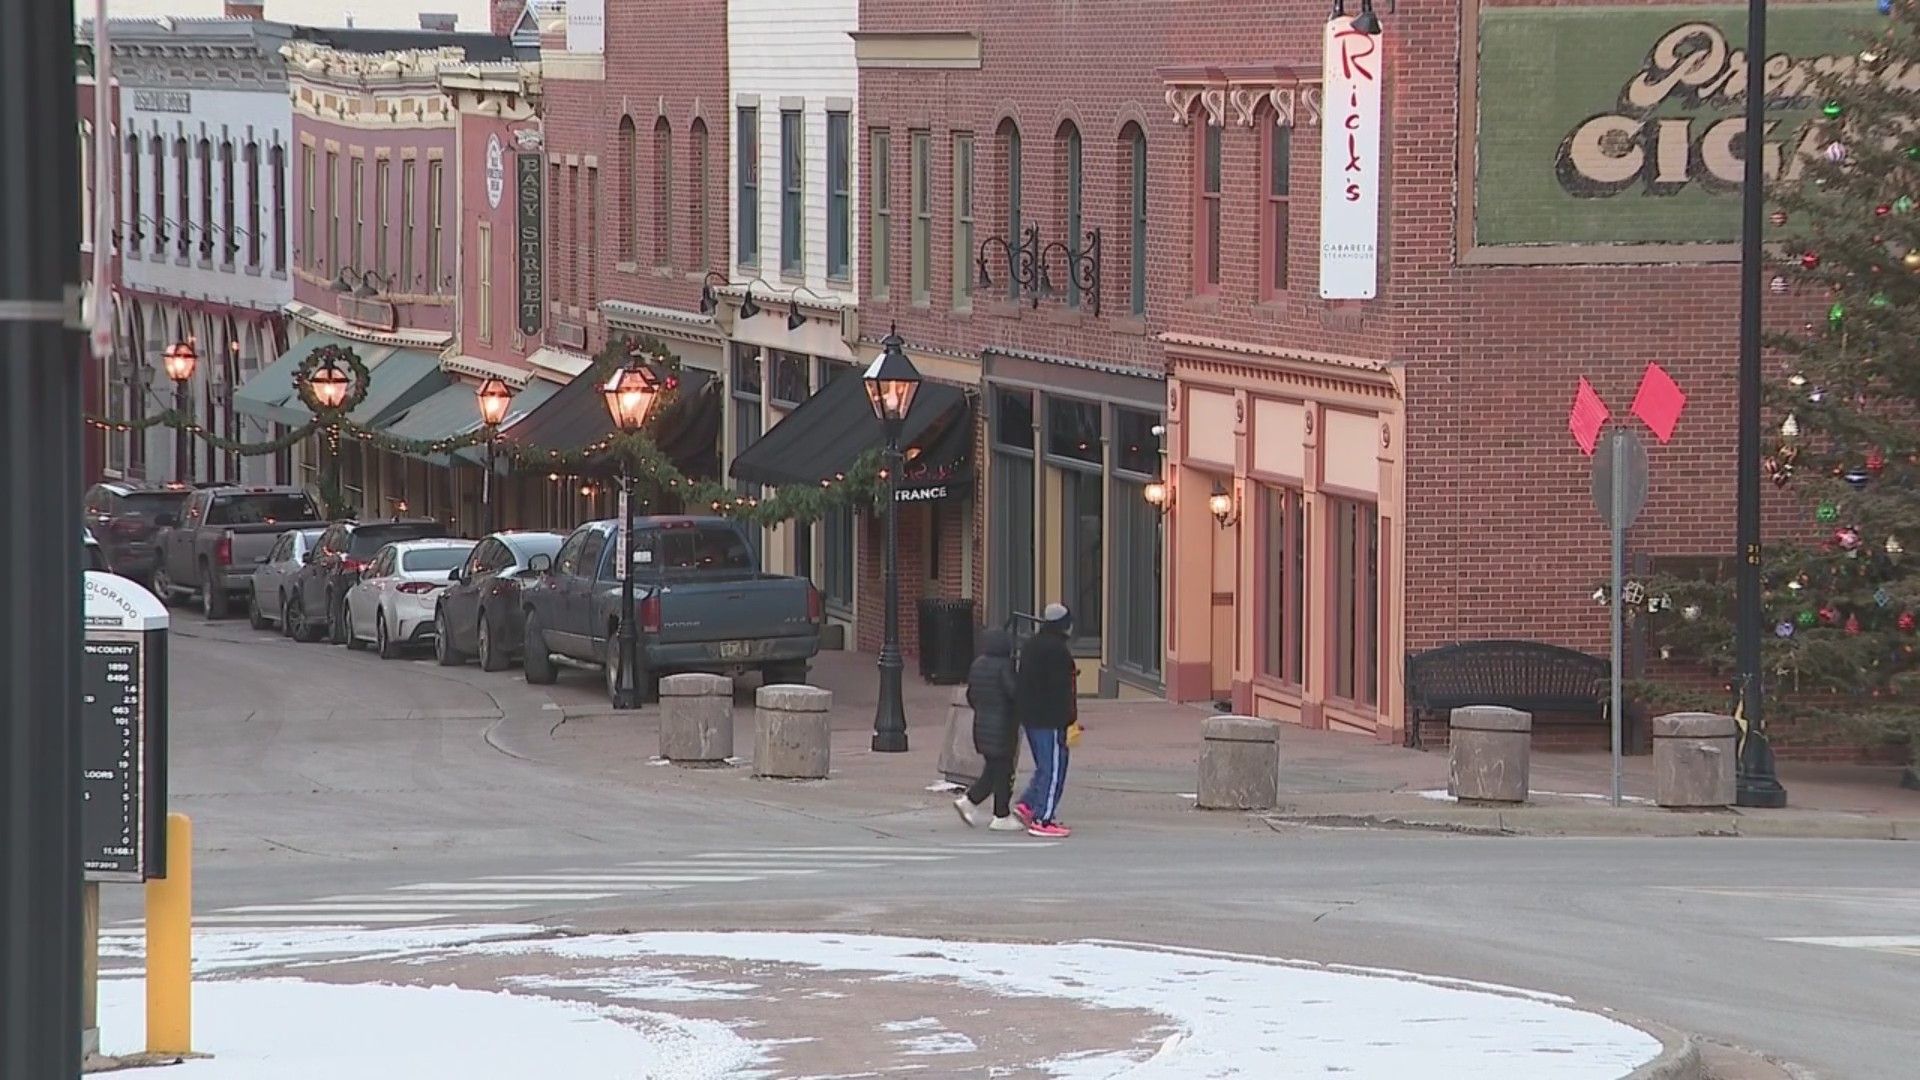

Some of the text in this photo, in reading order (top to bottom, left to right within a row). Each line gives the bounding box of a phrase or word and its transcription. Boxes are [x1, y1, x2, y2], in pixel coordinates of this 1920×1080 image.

[1334, 30, 1375, 201] Rick's
[521, 158, 541, 318] EASY STREET
[895, 486, 947, 501] TRANCE
[85, 581, 137, 619] OLORADO
[97, 645, 134, 655] COUNTY
[84, 770, 114, 779] LOORS
